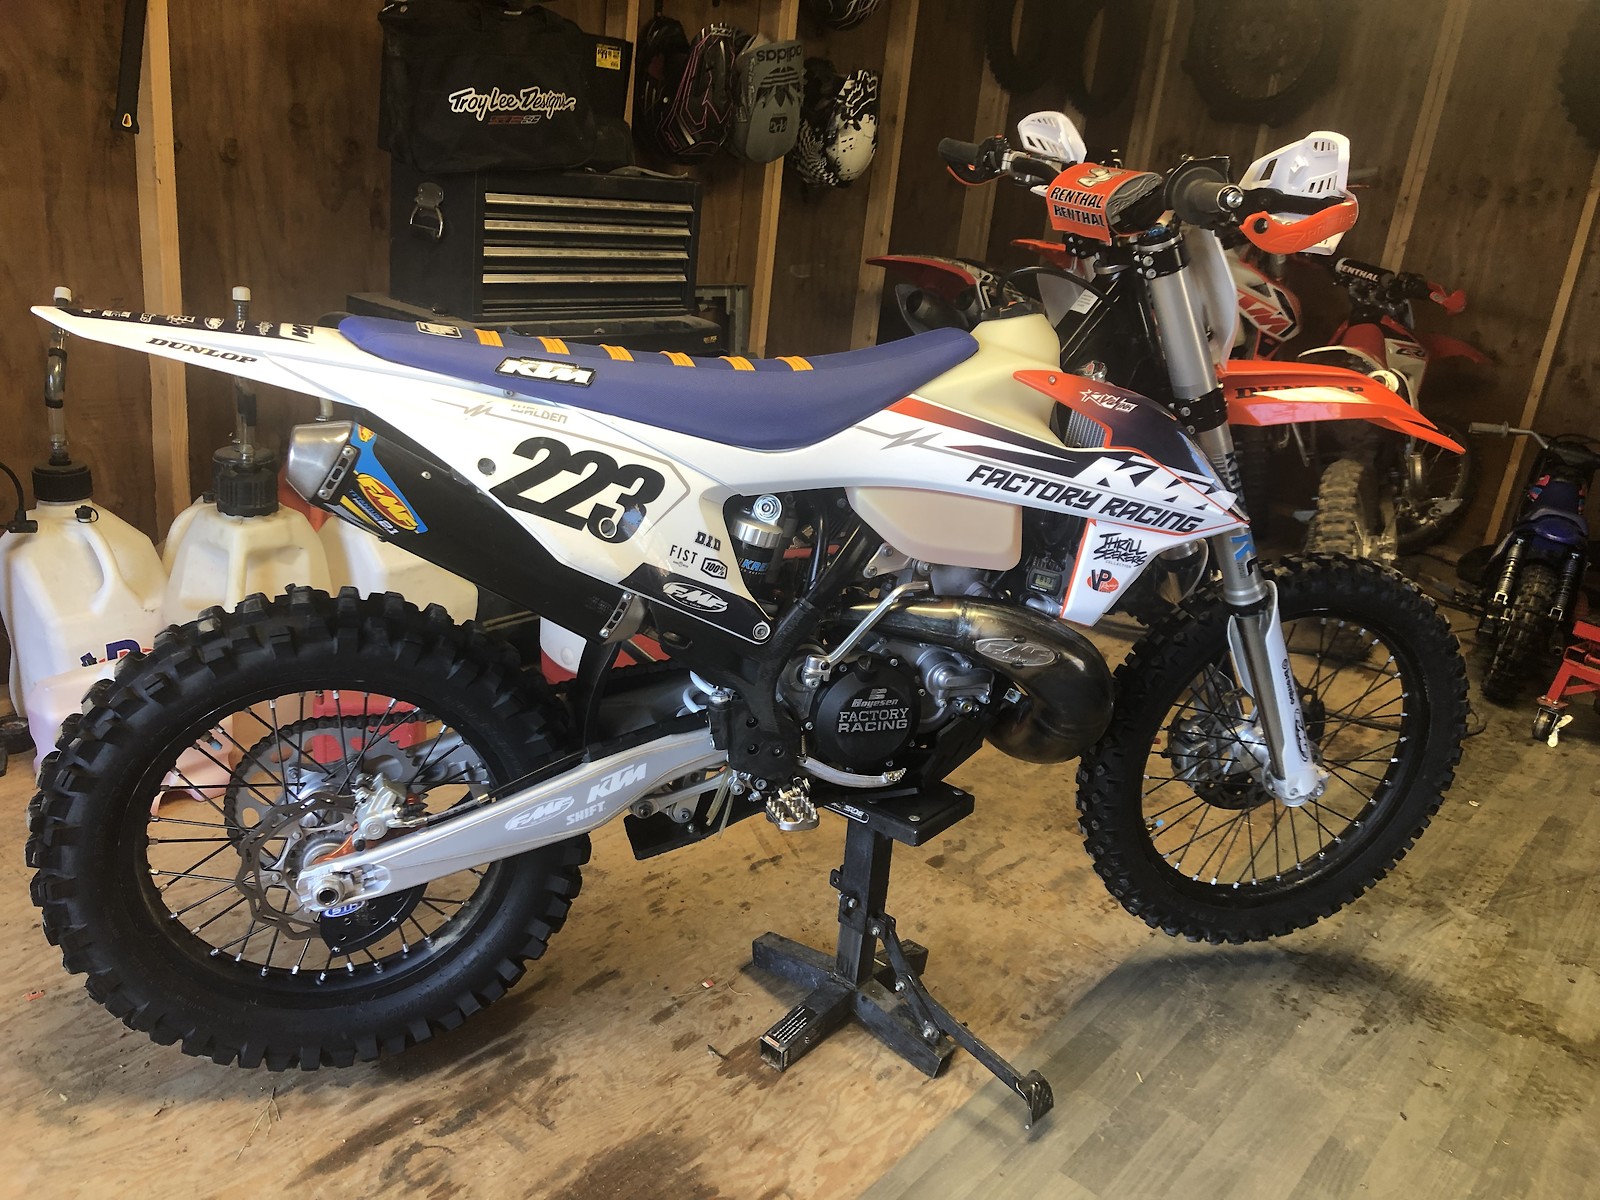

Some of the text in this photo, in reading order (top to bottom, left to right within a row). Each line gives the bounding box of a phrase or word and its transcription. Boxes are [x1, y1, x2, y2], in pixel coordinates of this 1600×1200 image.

[756, 45, 802, 63] adidas
[449, 86, 577, 121] Troy Lee Designs
[1050, 187, 1105, 209] RENTHAL
[1053, 205, 1106, 226] RENTHAL
[146, 337, 258, 364] DUNLOP
[500, 357, 593, 384] KTM
[511, 404, 568, 424] WALDEN
[355, 474, 419, 529] FMF
[488, 436, 666, 543] 223
[966, 464, 1206, 533] FACTORY RACING
[669, 544, 698, 564] FIST
[704, 560, 727, 577] 100%
[663, 582, 729, 609] FMF
[838, 707, 910, 723] FACTORY
[851, 698, 899, 709] Boyesen
[837, 719, 909, 733] RACING
[586, 762, 648, 804] KTM
[505, 796, 576, 832] FMF
[566, 801, 606, 826] SHIFT
